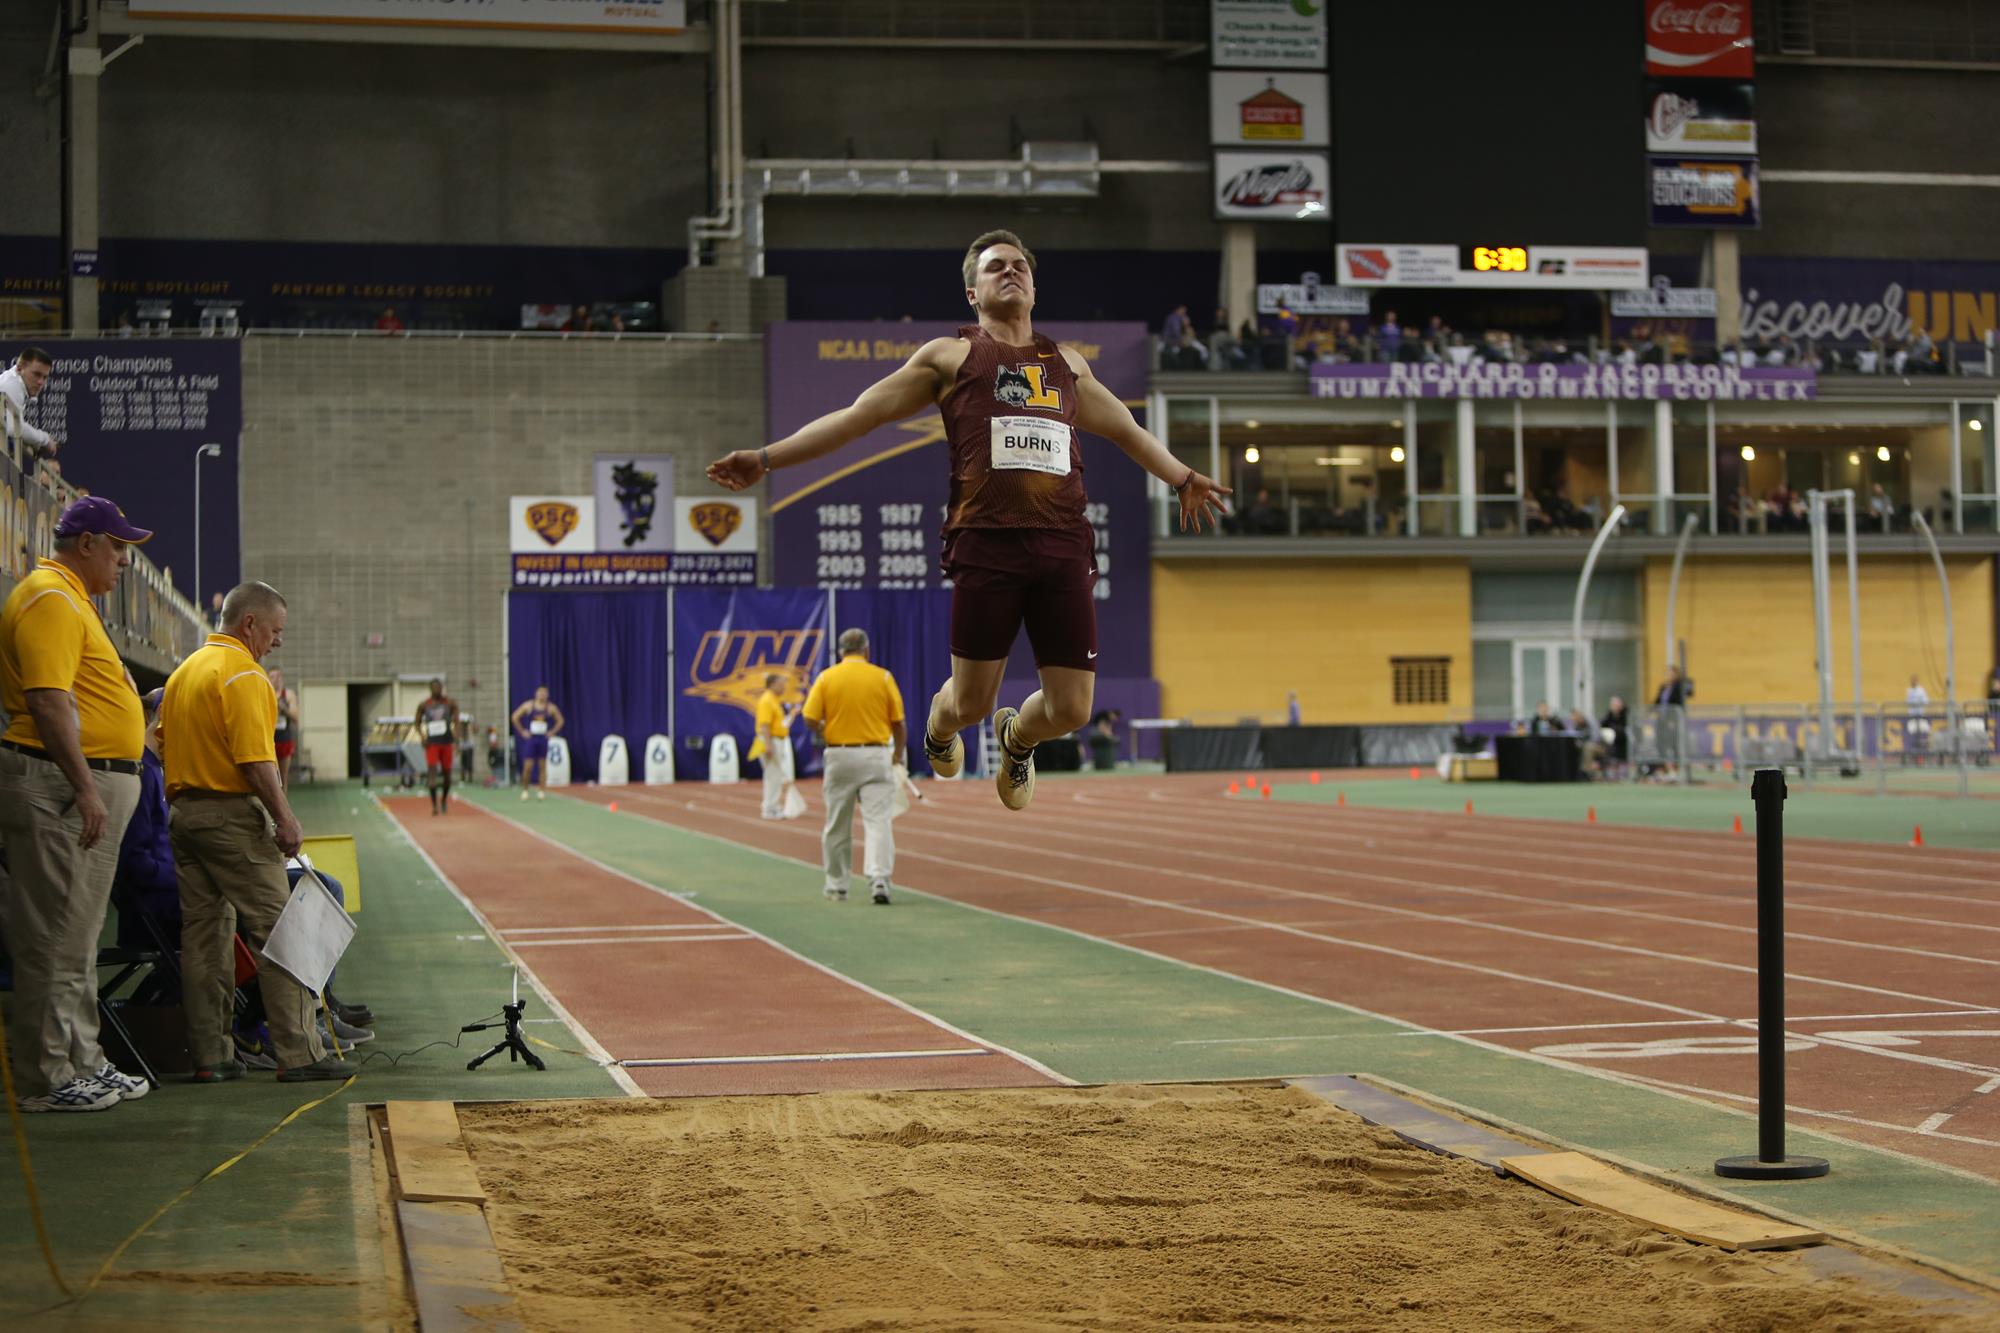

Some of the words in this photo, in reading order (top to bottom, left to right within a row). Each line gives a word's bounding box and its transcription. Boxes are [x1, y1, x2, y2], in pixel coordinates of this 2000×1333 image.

[1739, 282, 1913, 340] iscover
[818, 339, 870, 359] NCAA
[93, 355, 173, 374] Champions
[1391, 362, 1526, 382] RICHARD
[1583, 363, 1742, 384] JACOBSON
[90, 375, 138, 392] Outdoor
[141, 375, 174, 391] Track
[190, 375, 219, 391] Field
[1017, 362, 1063, 414] L
[1318, 378, 1423, 398] HUMAN
[1438, 378, 1660, 399] PERFORMANCE
[1674, 380, 1809, 400] COMPLEX
[1004, 435, 1061, 454] BURNS
[530, 507, 579, 525] PSC
[694, 507, 741, 525] PSC
[817, 504, 863, 526] 1985
[879, 504, 923, 526] 1987
[817, 530, 863, 551] 1993
[879, 530, 924, 551] 1994
[817, 555, 866, 577] 2003
[879, 555, 927, 577] 2005
[515, 569, 754, 587] SupportThePanthers.com
[690, 629, 825, 687] UNI
[549, 745, 562, 765] 8
[606, 743, 620, 764] 7
[653, 743, 666, 764] 6
[718, 743, 731, 764] 5
